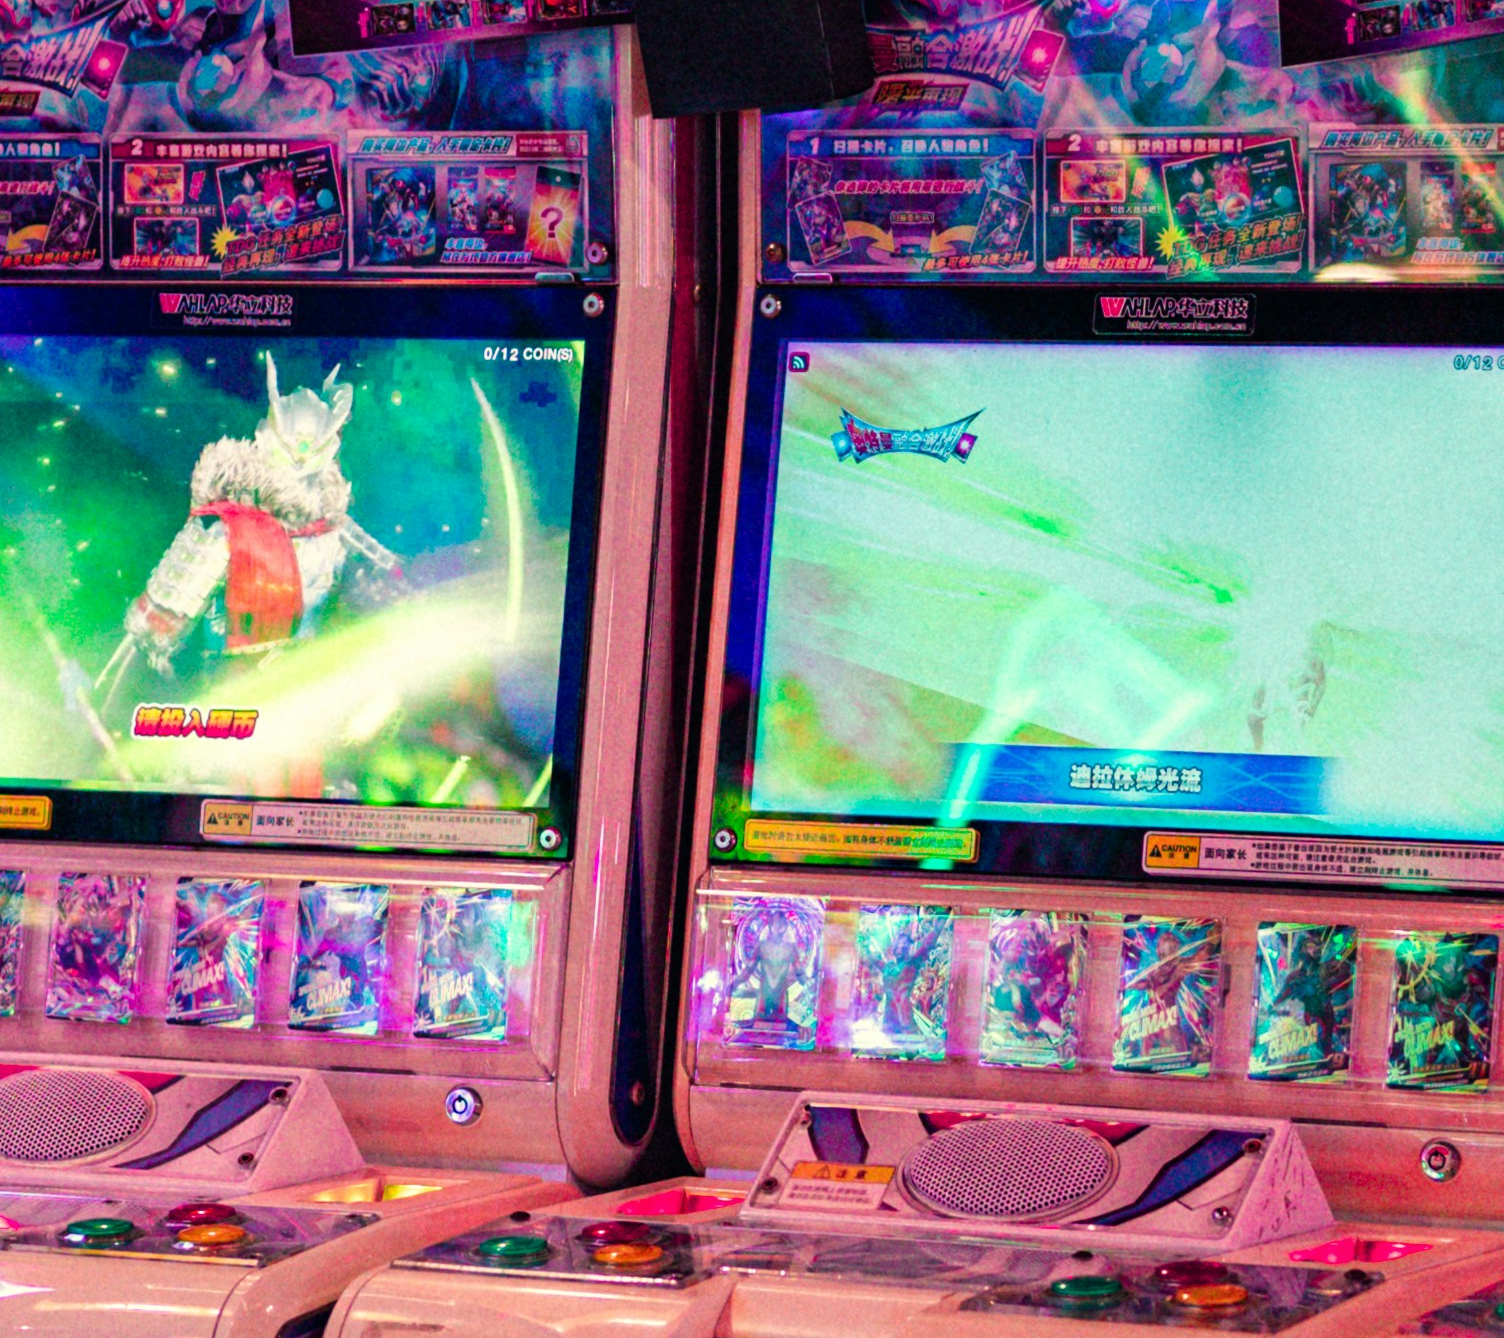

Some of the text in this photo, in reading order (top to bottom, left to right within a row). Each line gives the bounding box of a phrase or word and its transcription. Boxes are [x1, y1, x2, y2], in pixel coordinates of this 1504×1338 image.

[228, 292, 293, 317] 华立科技
[1176, 294, 1248, 321] 华立科技
[483, 346, 574, 364] 0/12 COIN(S)
[1453, 354, 1493, 370] 0/12
[133, 706, 259, 739] 请投入硬币
[256, 814, 295, 830] 面向家长
[1160, 843, 1199, 855] CAUTION
[1204, 847, 1248, 862] 面向家长
